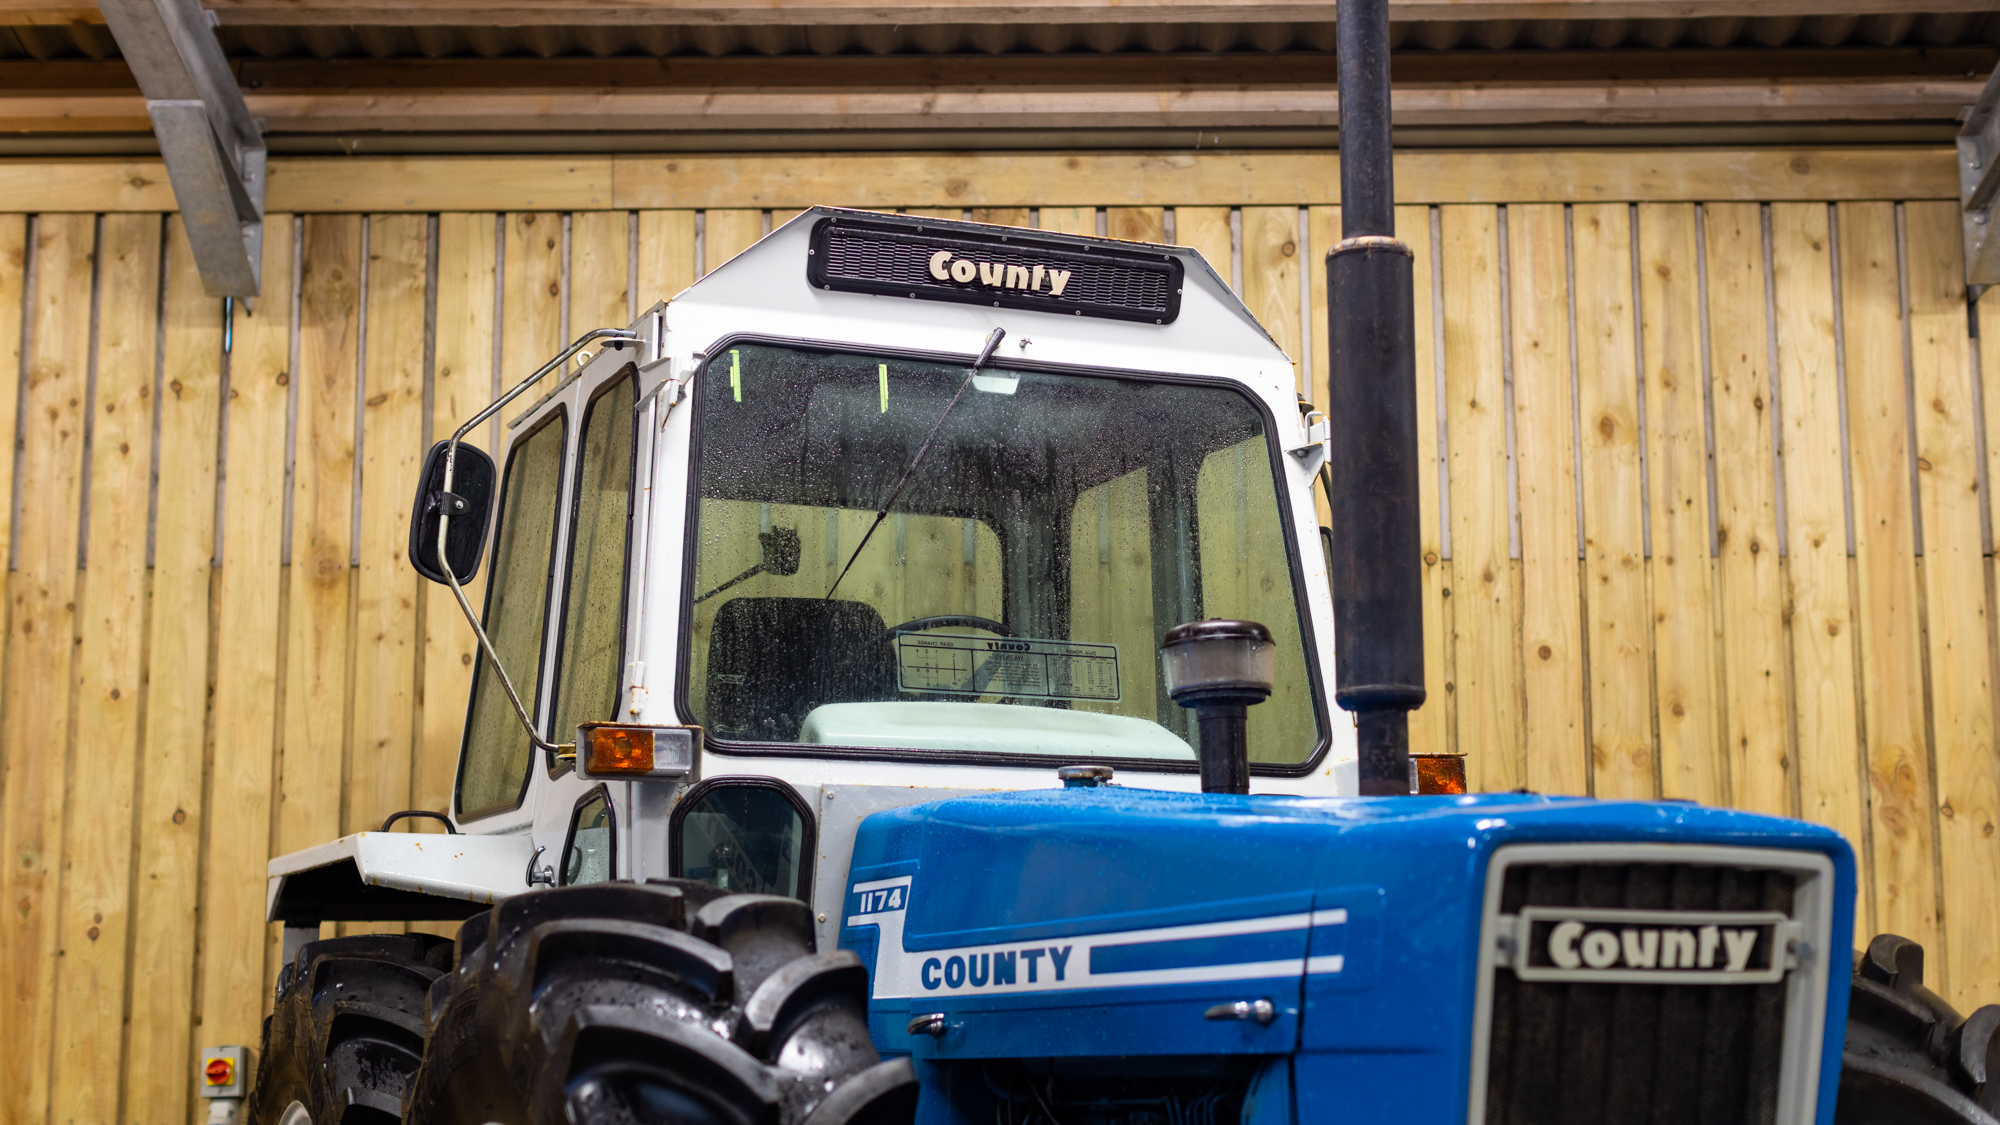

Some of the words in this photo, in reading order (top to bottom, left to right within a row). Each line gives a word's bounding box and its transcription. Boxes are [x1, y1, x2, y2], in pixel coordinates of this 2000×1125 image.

[929, 250, 1071, 296] County
[860, 888, 901, 913] 1174
[921, 945, 1073, 990] COUNTY
[1548, 920, 1758, 972] County
